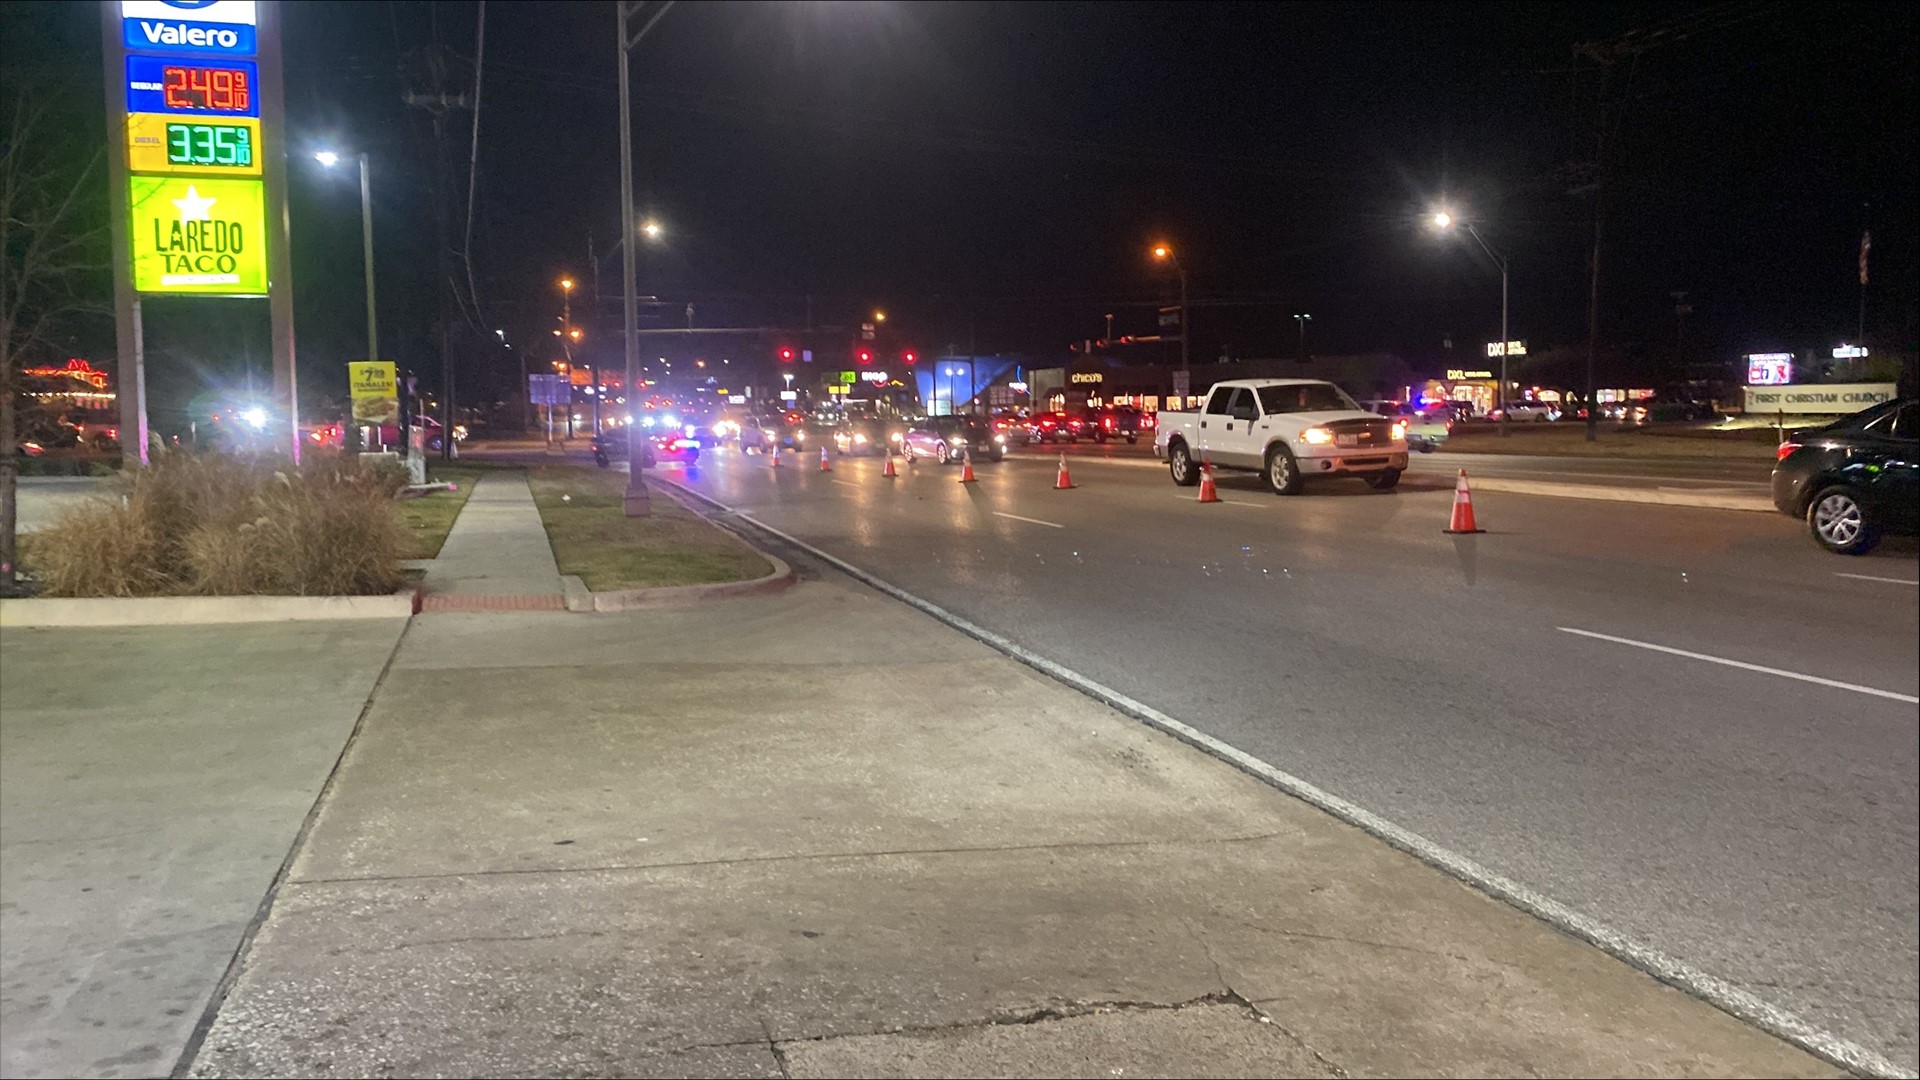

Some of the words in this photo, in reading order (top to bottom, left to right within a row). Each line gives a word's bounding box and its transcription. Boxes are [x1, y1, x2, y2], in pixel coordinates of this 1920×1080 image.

[141, 22, 238, 48] Valero
[154, 217, 243, 254] LAREDO
[157, 253, 237, 274] TACO
[1447, 370, 1466, 380] DXL
[1756, 394, 1781, 404] FIRST
[1785, 393, 1838, 403] CHRISTIAN
[1843, 392, 1889, 403] CHURCH
